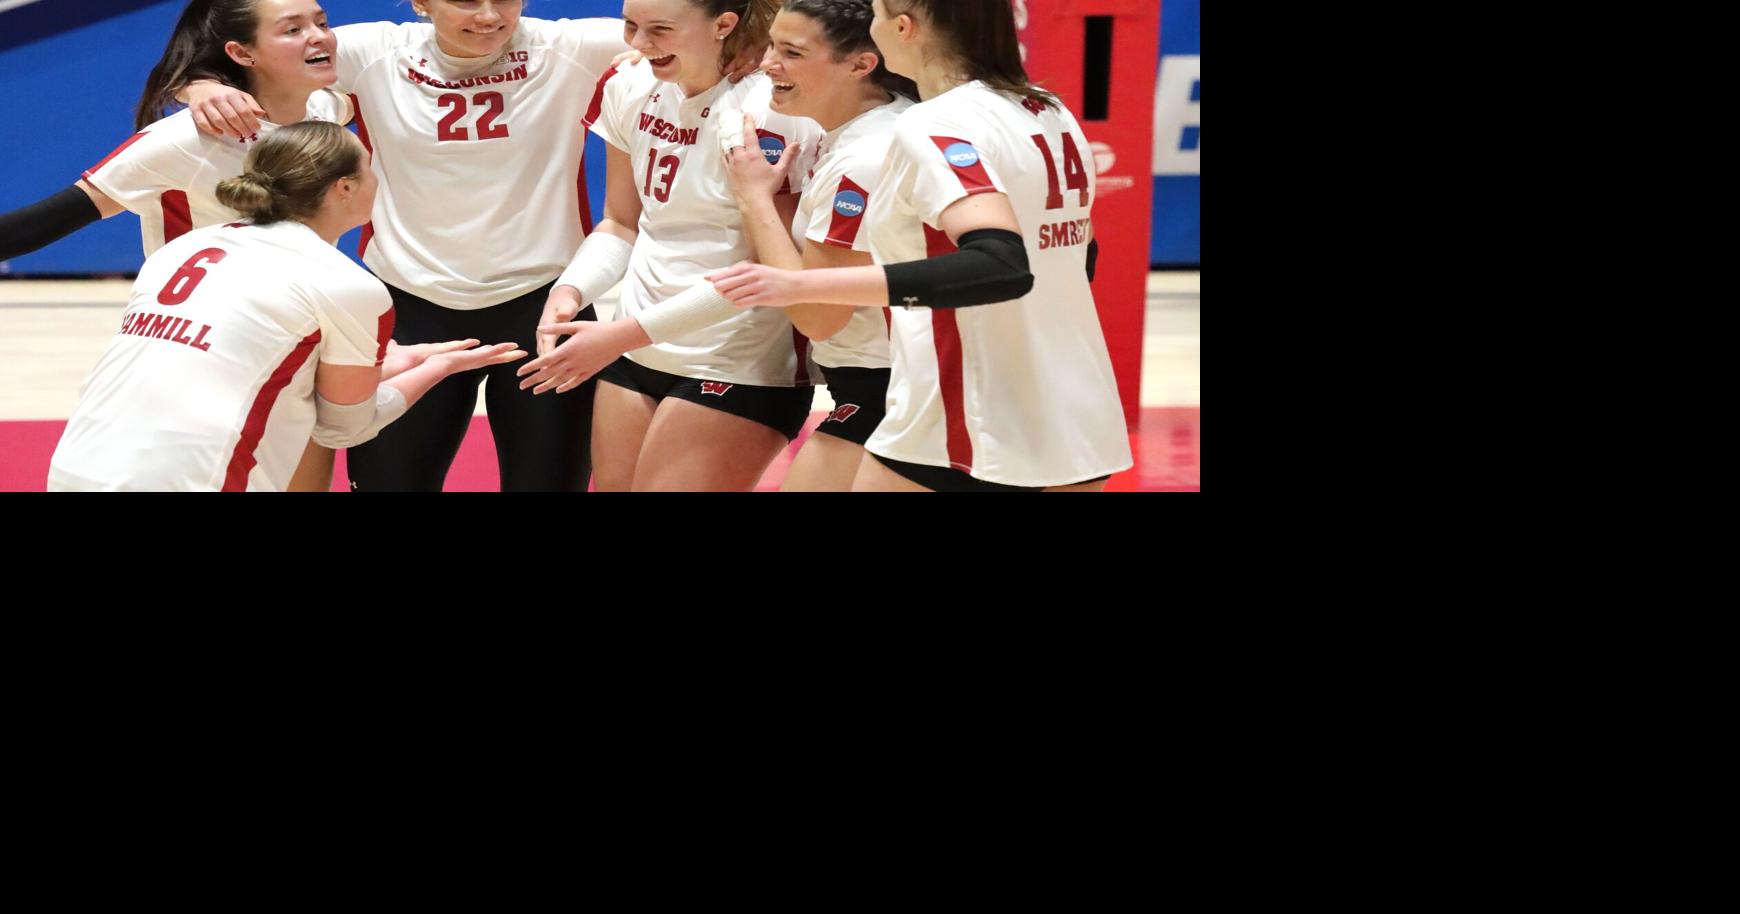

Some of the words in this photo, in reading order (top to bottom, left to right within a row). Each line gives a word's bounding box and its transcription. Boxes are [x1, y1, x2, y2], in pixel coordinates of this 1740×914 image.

[437, 91, 509, 141] 22
[644, 147, 681, 203] 13
[949, 152, 977, 162] NCAA
[1031, 131, 1089, 210] 14
[836, 201, 862, 213] NCAA
[157, 247, 227, 306] 6
[121, 312, 212, 352] AMMILL
